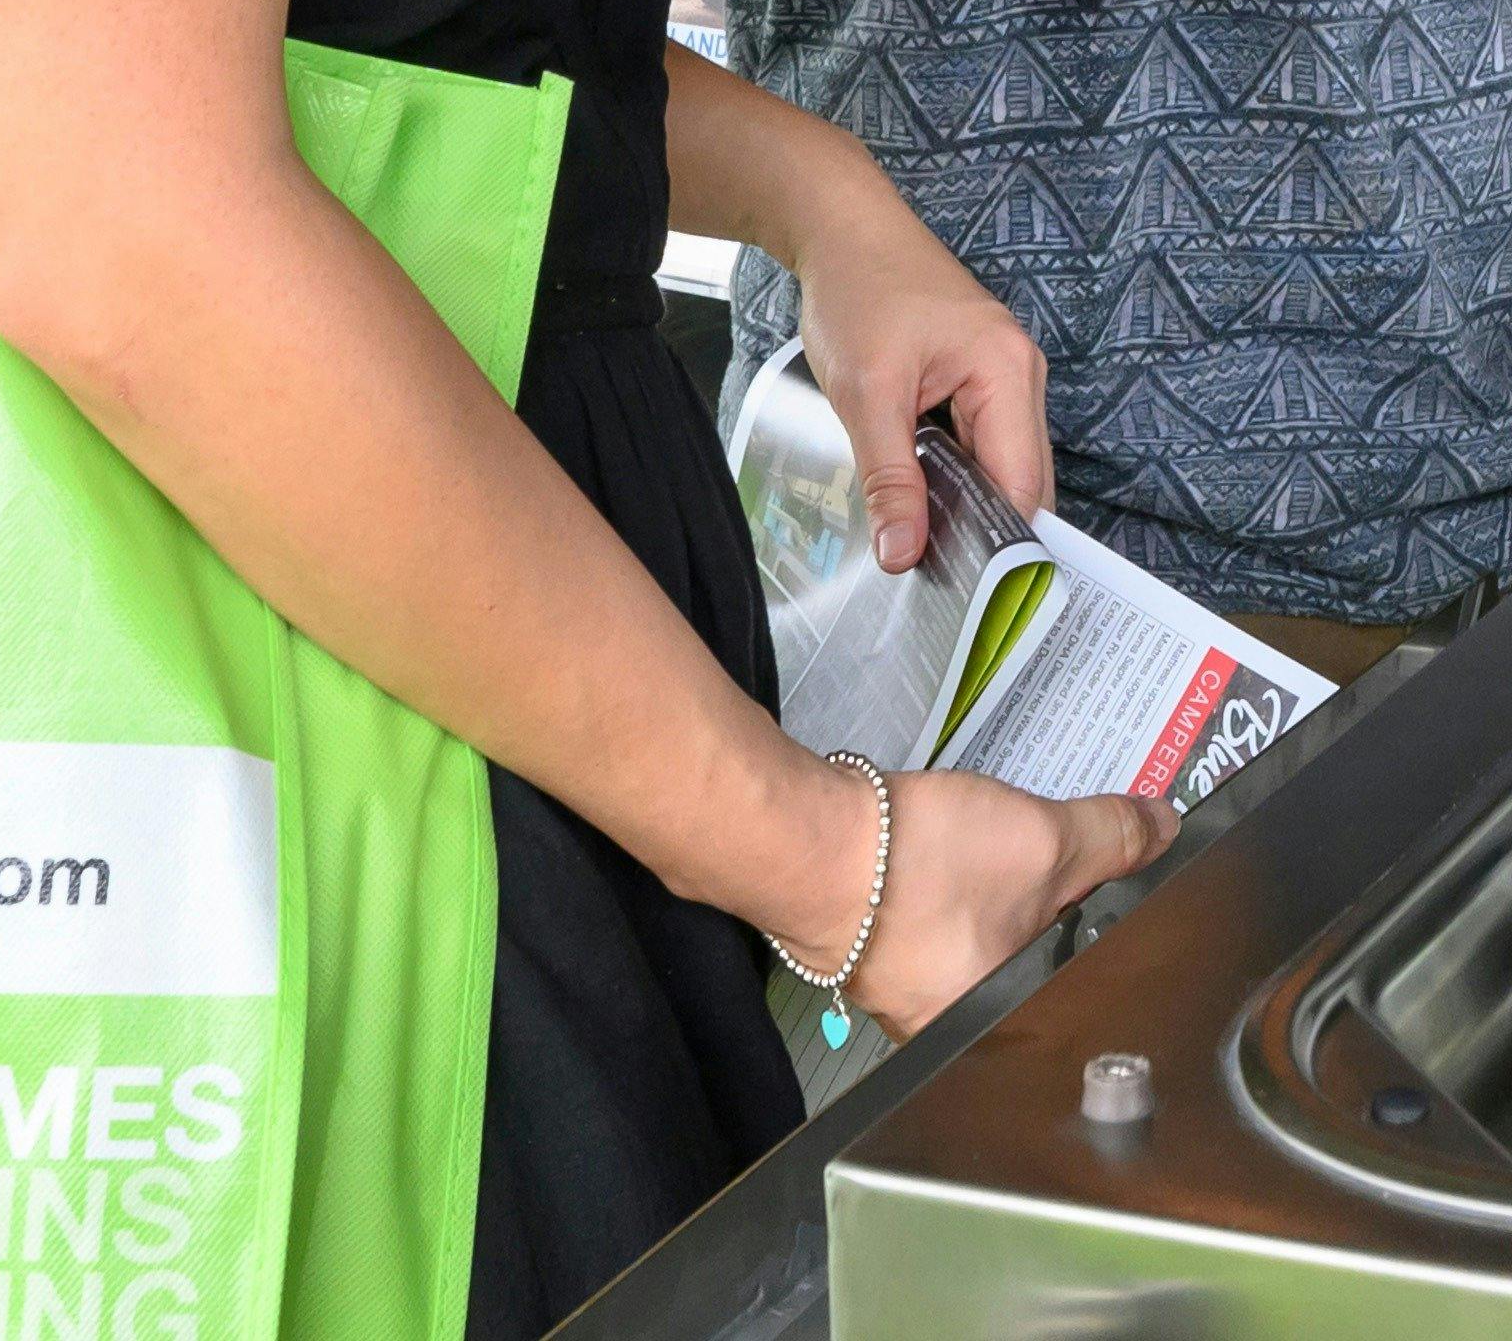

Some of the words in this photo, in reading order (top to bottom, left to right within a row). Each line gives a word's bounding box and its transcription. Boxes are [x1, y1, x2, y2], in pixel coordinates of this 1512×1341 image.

[1054, 578, 1089, 626] Upgrade
[1098, 599, 1122, 629] Extra
[1047, 623, 1061, 638] to
[1057, 632, 1080, 661] DHA
[1085, 626, 1104, 648] gas
[1138, 630, 1171, 677] Mattress
[1154, 640, 1188, 687] Mattress
[1038, 658, 1065, 693] Diesel
[1057, 676, 1077, 700] and
[1084, 658, 1110, 691] under
[1025, 691, 1045, 714] Hot
[1006, 712, 1033, 747] Water
[1030, 716, 1053, 745] BBQ
[1133, 666, 1224, 801] CAMPERS
[1188, 687, 1282, 794] Blue
[986, 745, 1014, 779] Syste
[1016, 742, 1036, 765] gas
[1026, 756, 1052, 788] cycle
